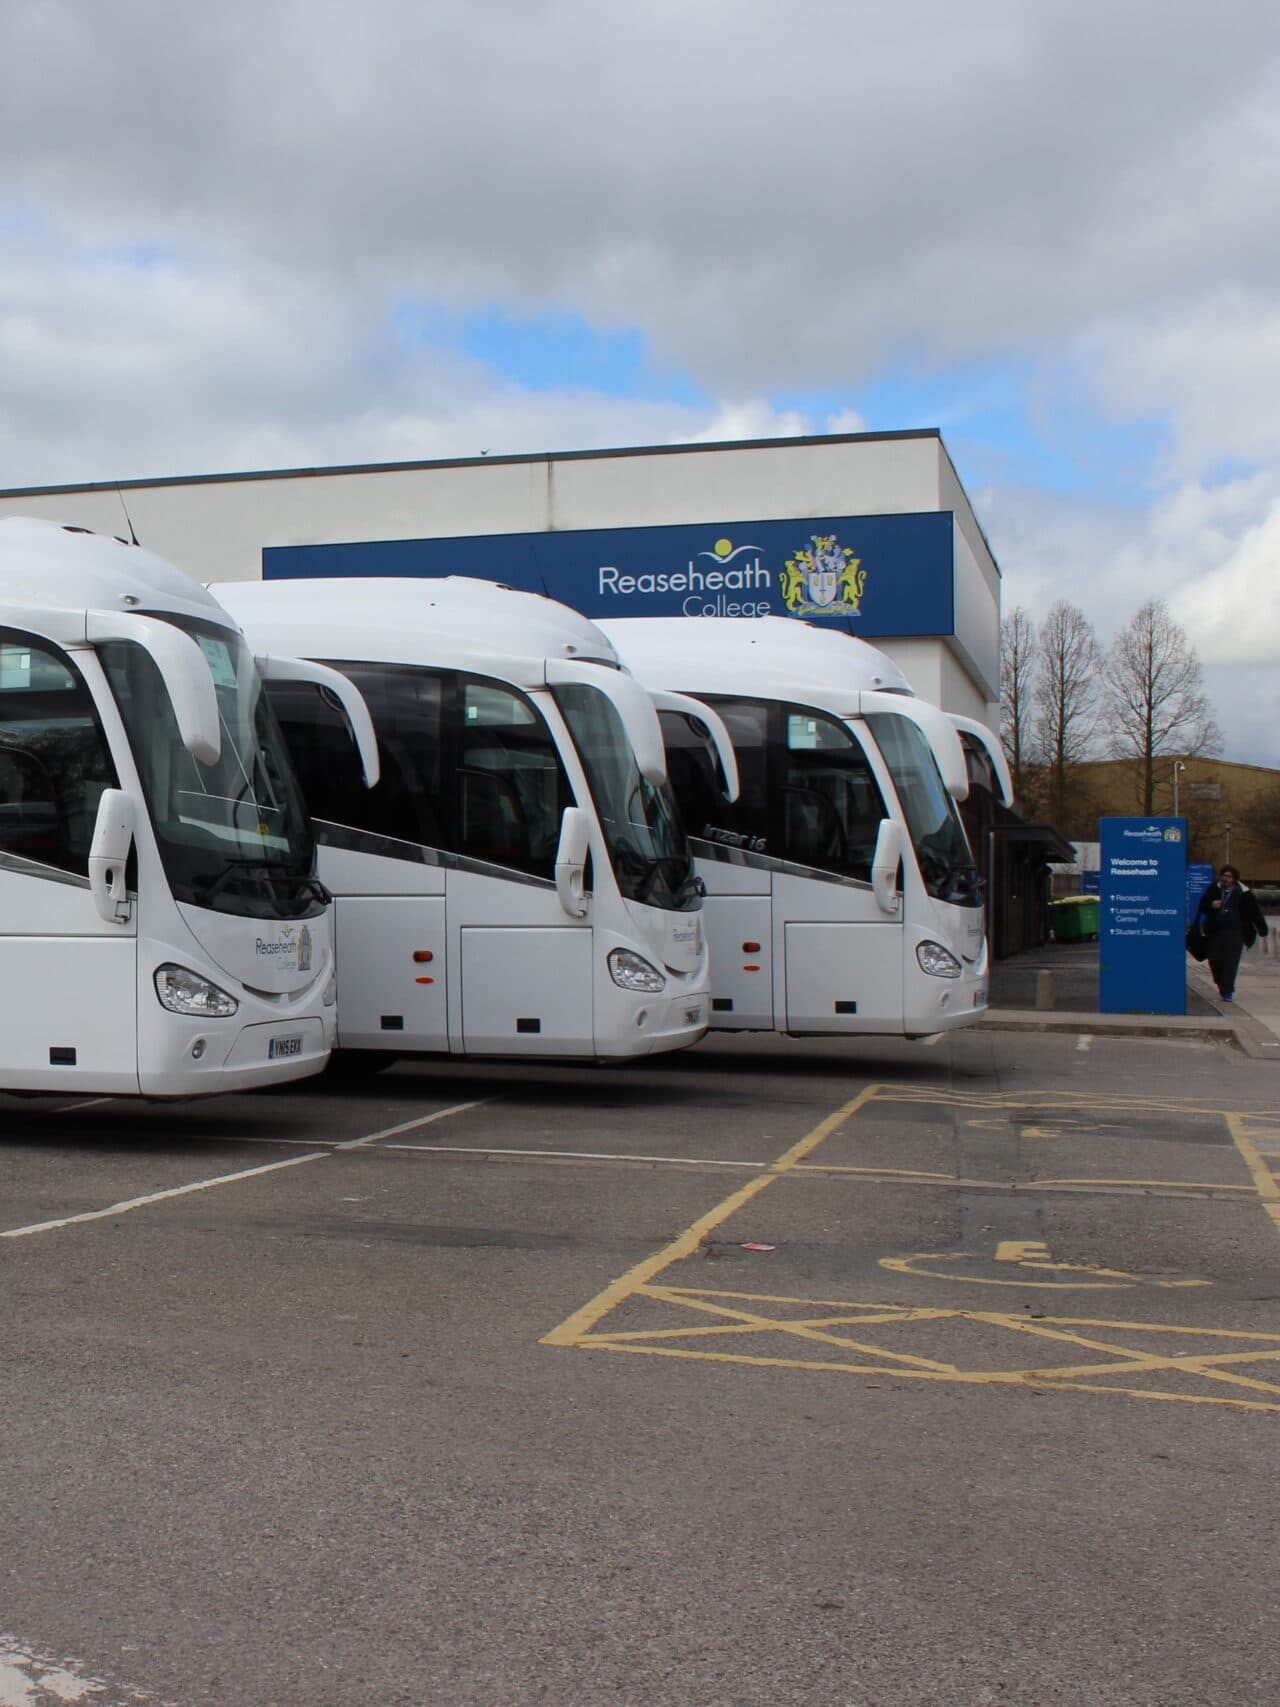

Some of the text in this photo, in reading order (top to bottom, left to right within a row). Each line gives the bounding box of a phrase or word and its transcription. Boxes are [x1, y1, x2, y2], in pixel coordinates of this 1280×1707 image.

[598, 558, 771, 595] Reaseheath
[682, 595, 771, 618] College
[1110, 858, 1158, 866] Welcome to
[1110, 867, 1158, 876] Reaseheath
[1115, 894, 1150, 902] Reception
